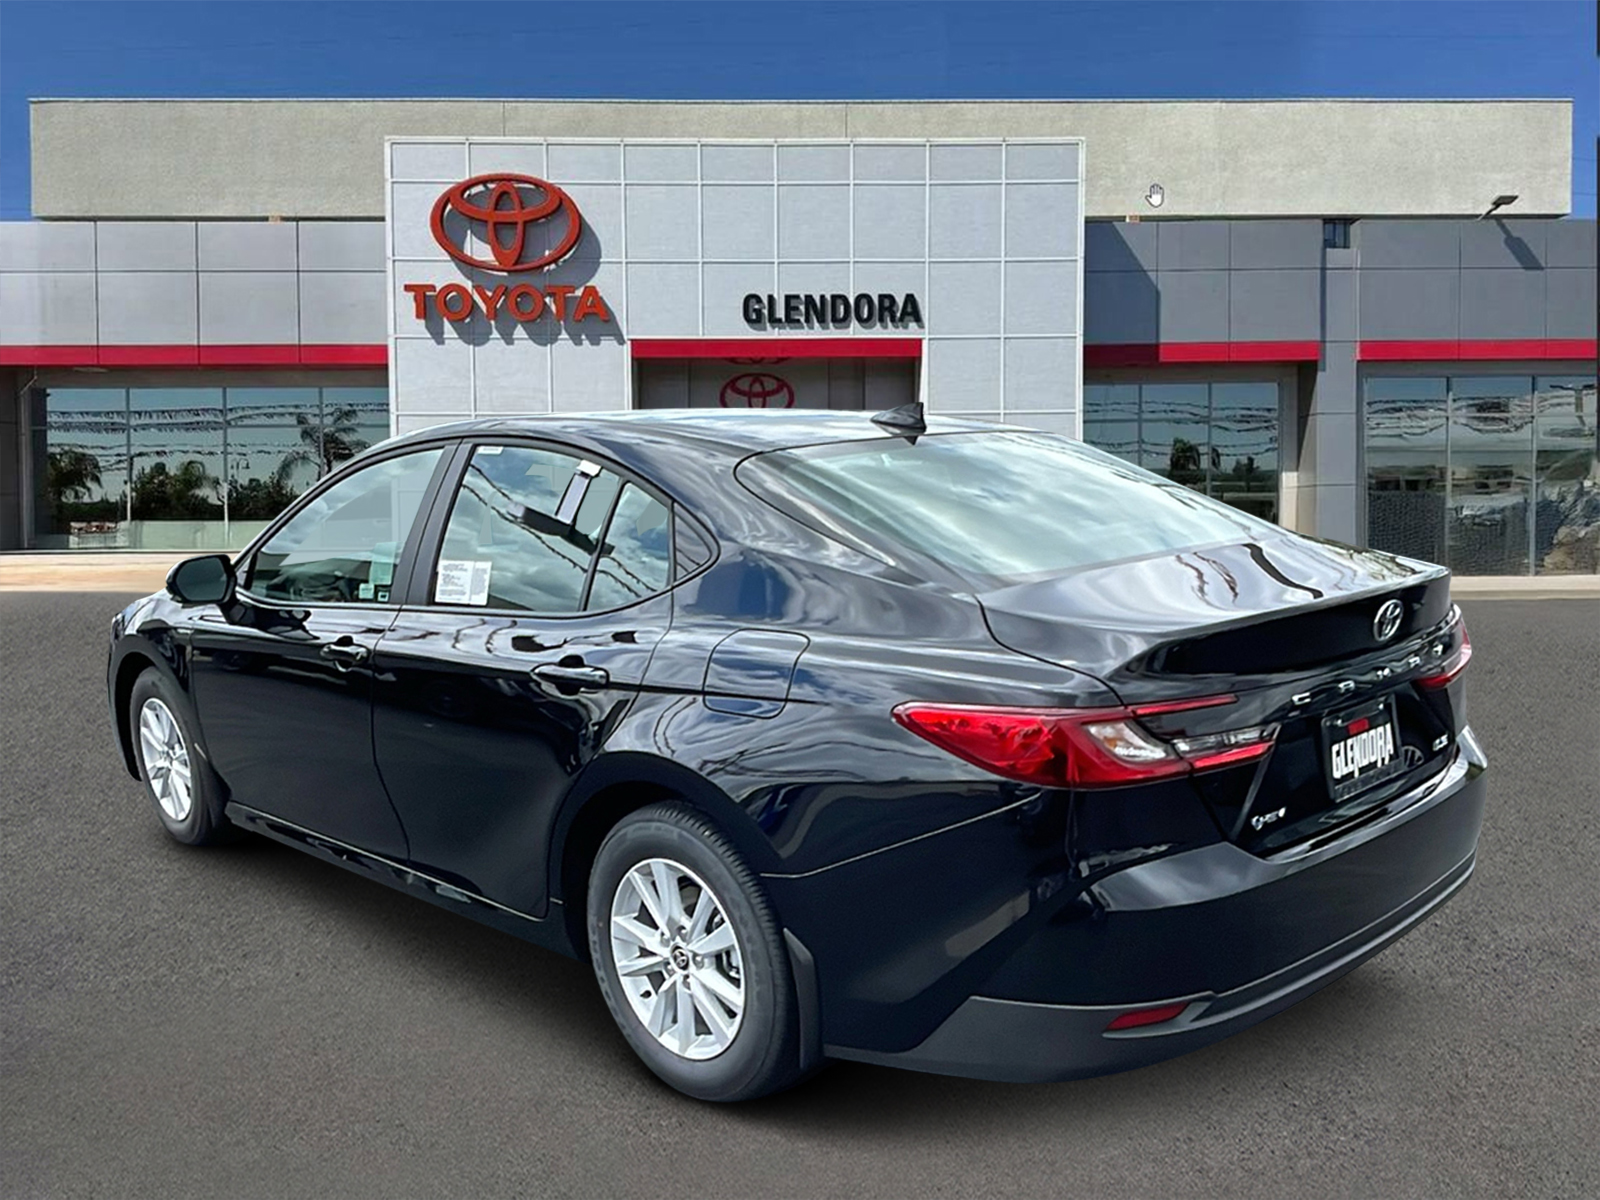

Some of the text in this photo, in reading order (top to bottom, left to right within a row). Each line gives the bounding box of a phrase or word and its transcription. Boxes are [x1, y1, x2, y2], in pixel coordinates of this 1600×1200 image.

[404, 283, 611, 323] TOYOTA
[742, 292, 922, 325] GLENDORA
[1331, 722, 1394, 779] GLENDORA
